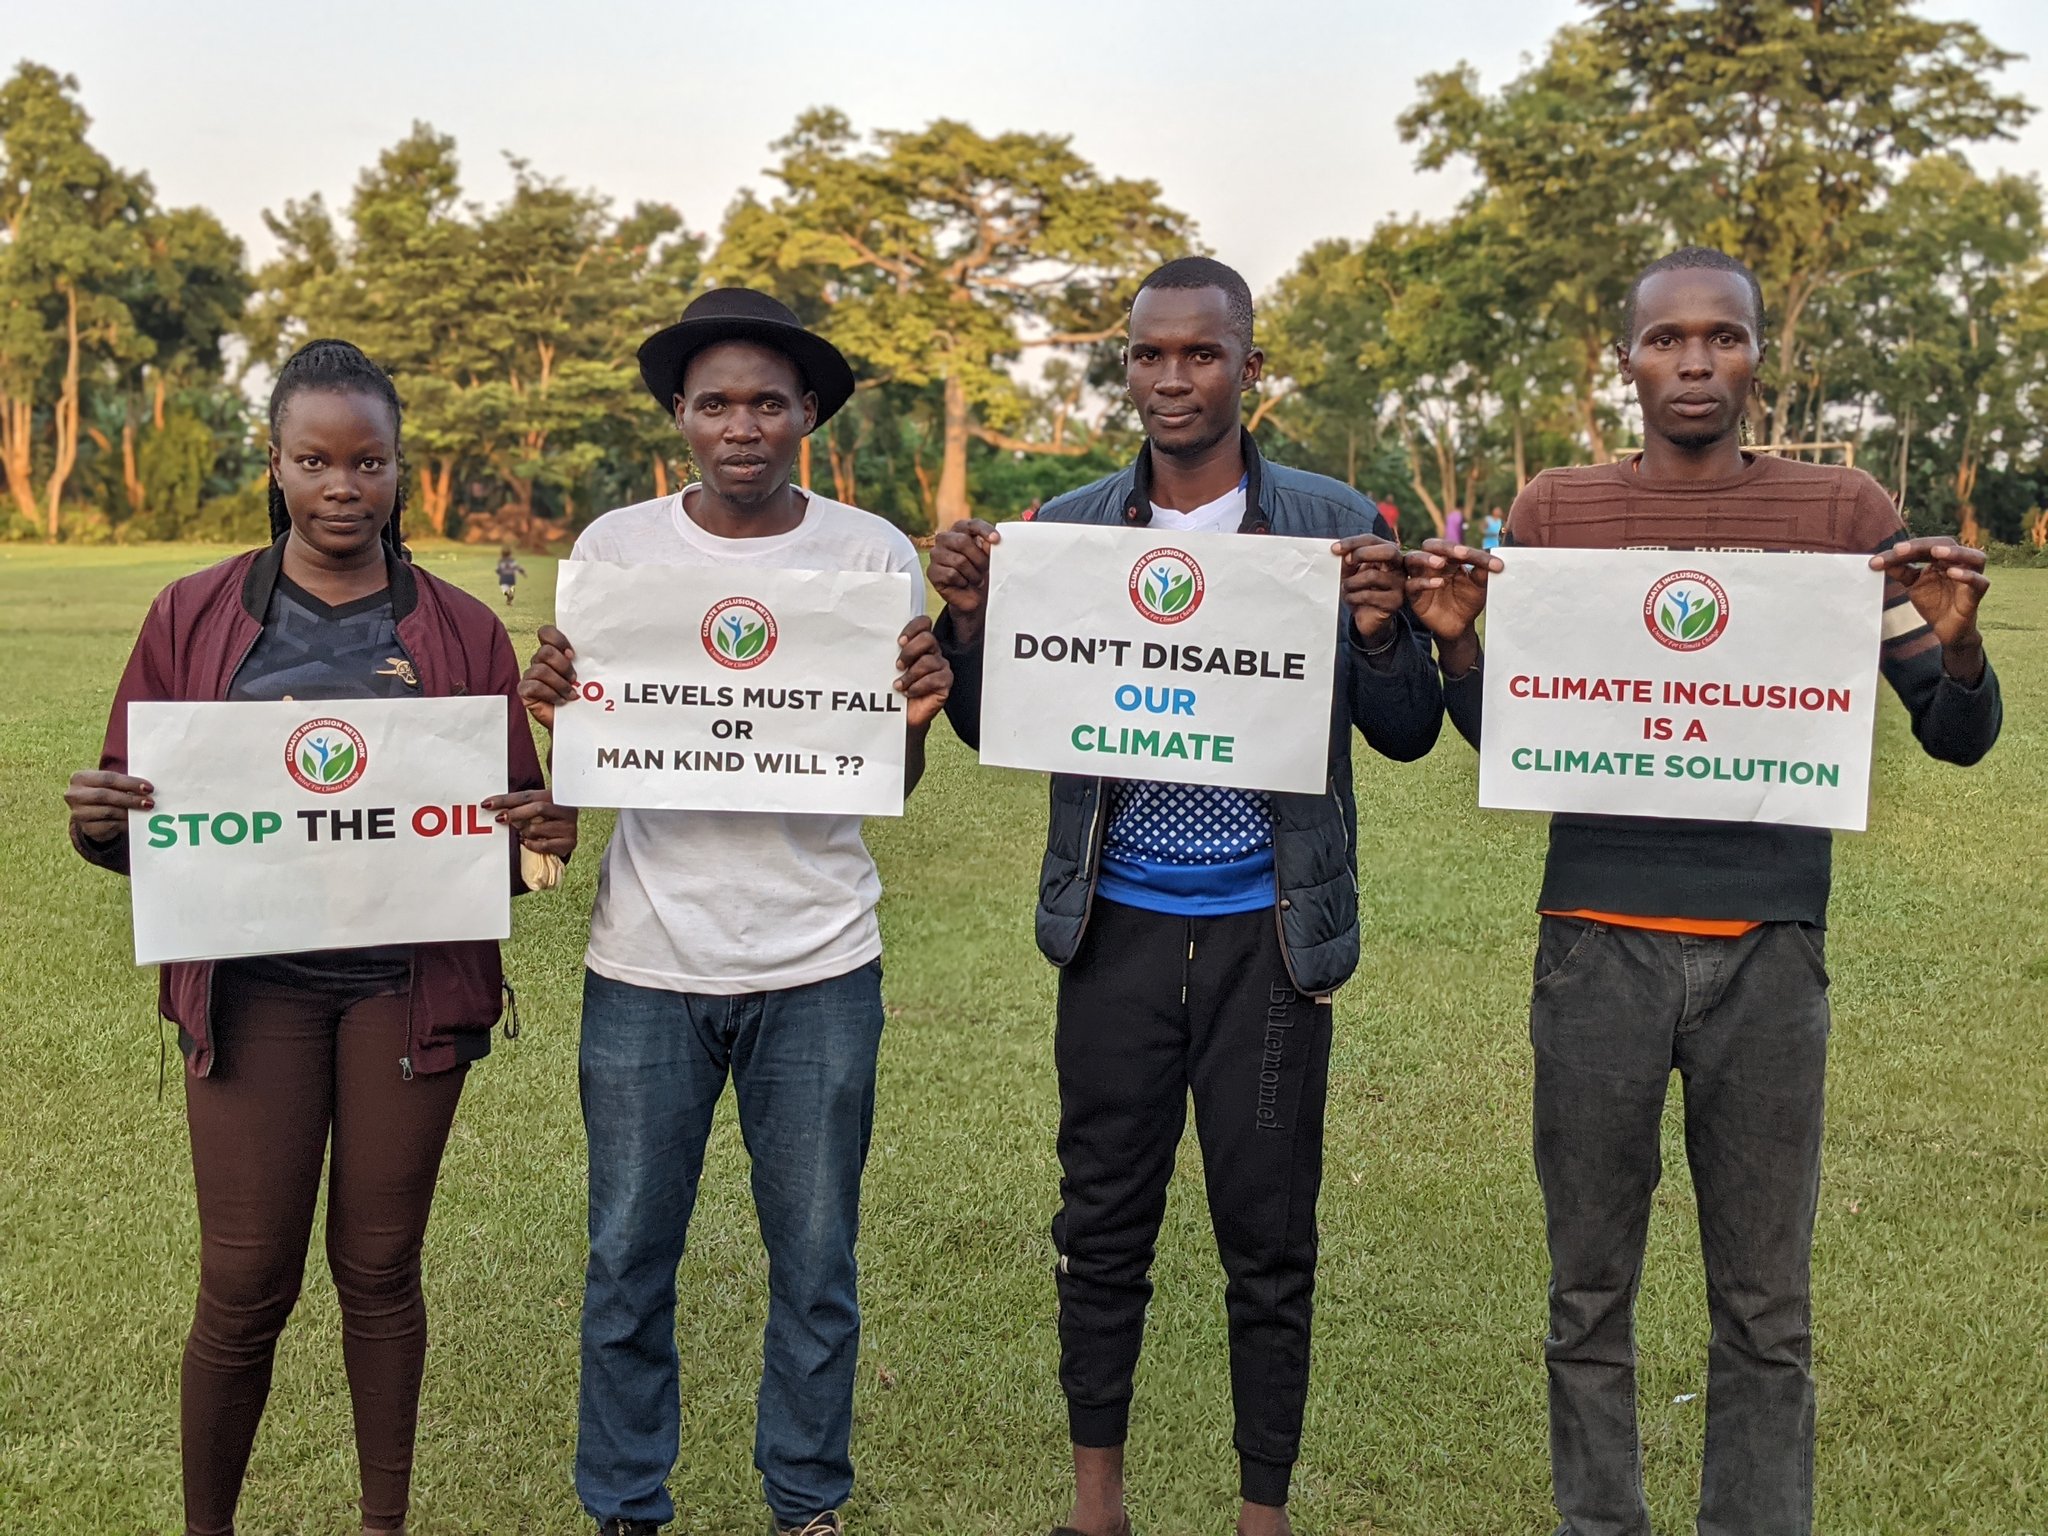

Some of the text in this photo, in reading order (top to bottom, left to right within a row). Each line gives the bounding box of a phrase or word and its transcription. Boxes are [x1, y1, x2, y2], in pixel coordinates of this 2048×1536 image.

[1130, 550, 1202, 591] CLIMATE INCLUSION NETWORK
[1646, 572, 1727, 616] CLIMATE INCLUSION NETWORK
[703, 598, 776, 638] CLIMATE INCLUSION NETWORK
[1014, 633, 1305, 680] DON’T DISABLE
[624, 683, 733, 706] LEVELS
[744, 688, 822, 710] MUST
[832, 691, 901, 712] FALL
[1115, 685, 1195, 715] OUR
[1509, 676, 1850, 712] CLIMATE INCLUSION
[287, 720, 366, 761] CLIMATE INCLUSION NETWORK
[712, 720, 752, 739] OR
[1071, 725, 1234, 762] CLIMATE
[1643, 718, 1707, 742] IS A
[597, 749, 864, 776] MAN KIND WILL ??
[1511, 748, 1839, 786] CLIMATE SOLUTION
[148, 805, 492, 848] STOP THE OIL
